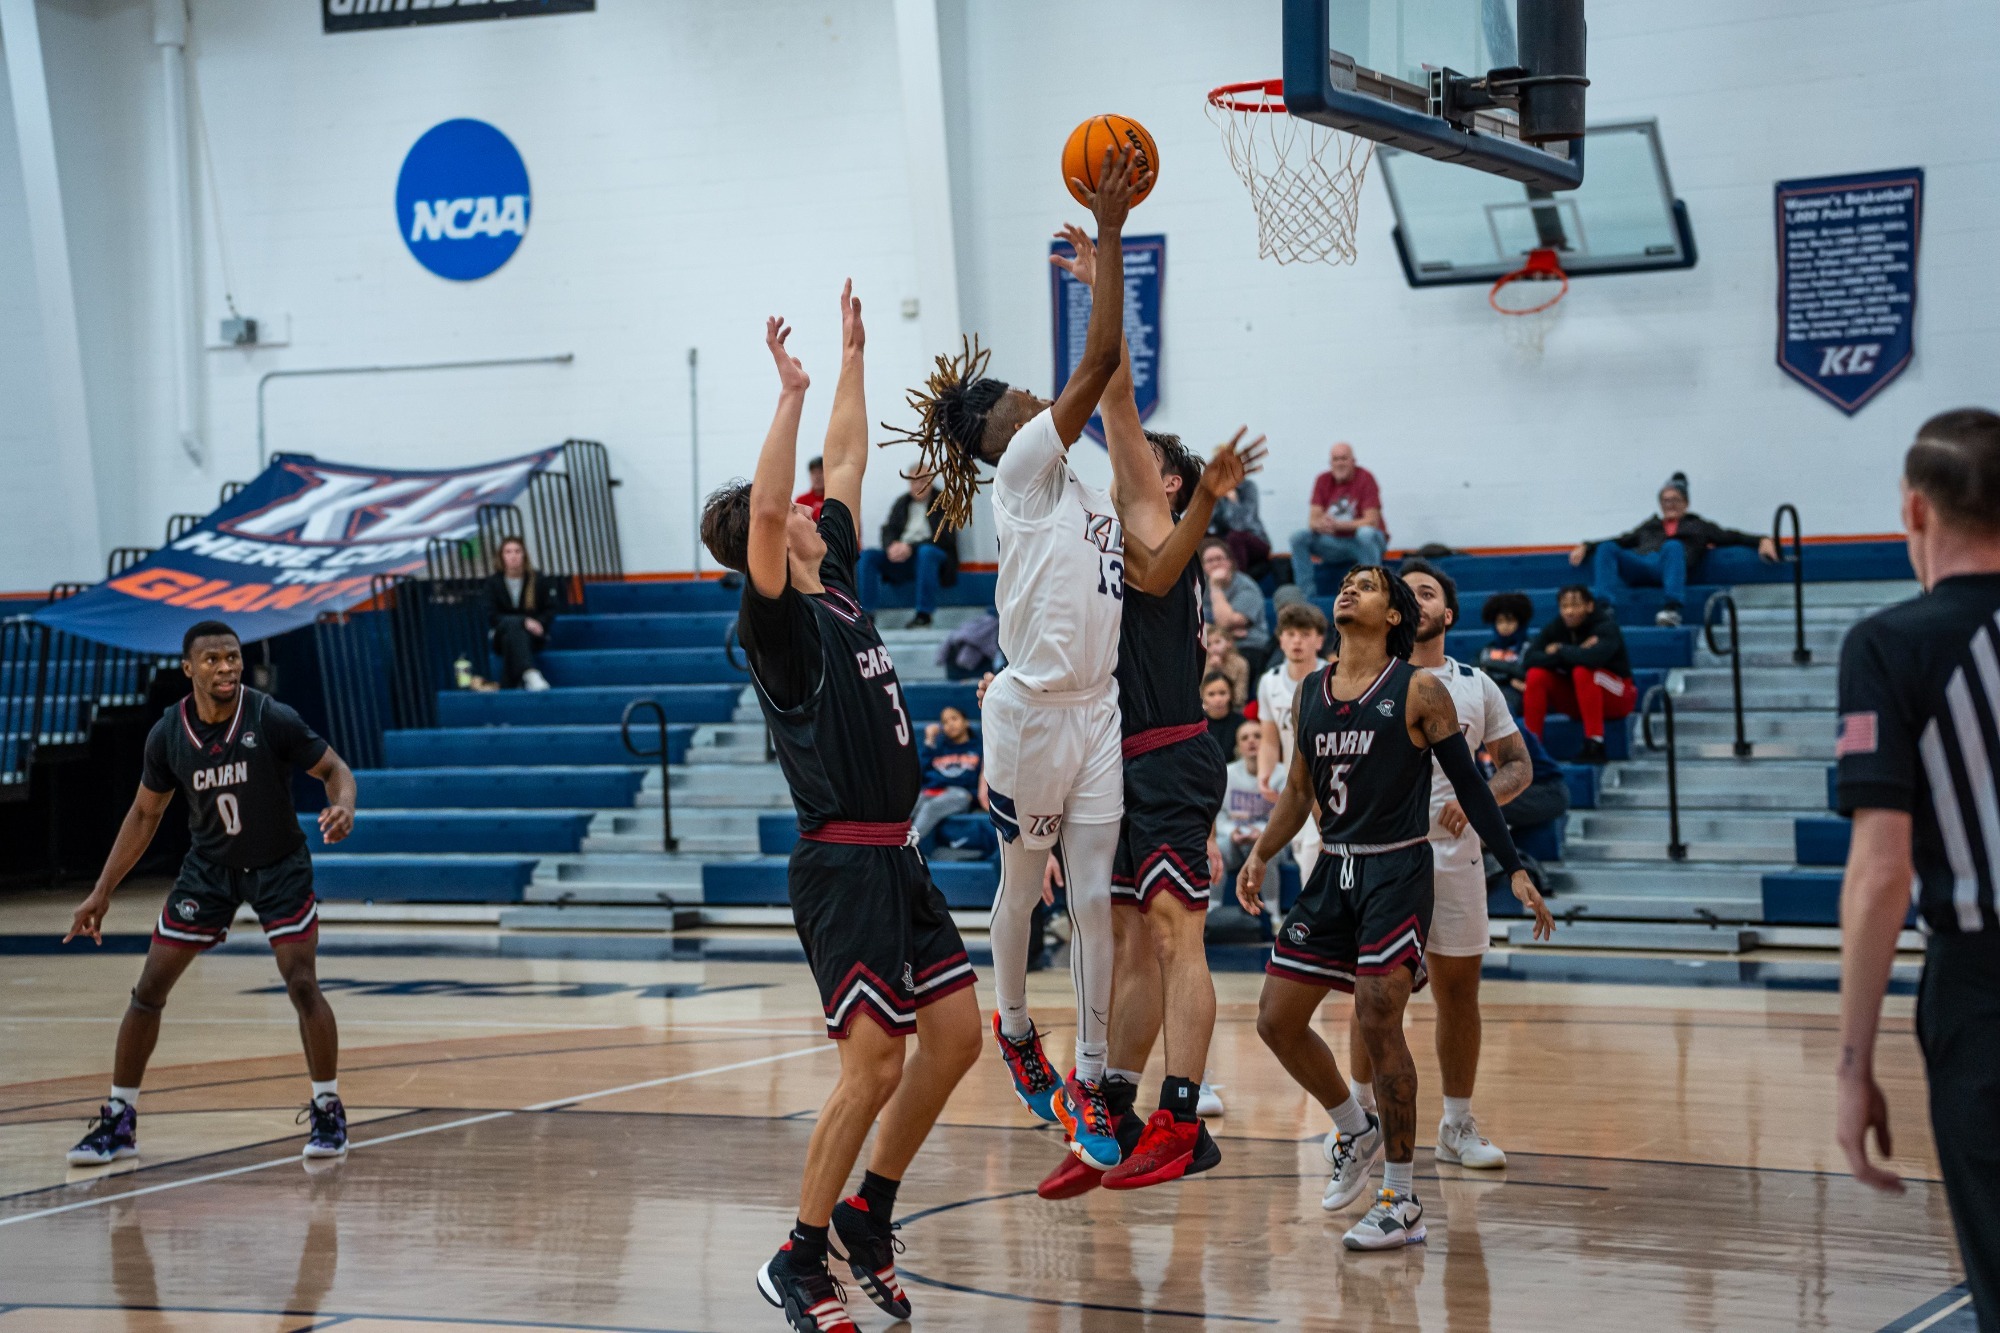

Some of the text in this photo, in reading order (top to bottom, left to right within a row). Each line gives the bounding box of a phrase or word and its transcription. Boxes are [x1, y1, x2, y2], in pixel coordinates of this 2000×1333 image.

[410, 195, 525, 242] NCAA
[1819, 343, 1881, 377] KC
[172, 531, 335, 569] HERE
[1098, 554, 1124, 601] 13
[883, 681, 910, 746] 3
[1315, 730, 1375, 757] CAIRN
[193, 761, 248, 791] CAIRN
[1328, 763, 1351, 815] 5
[216, 793, 242, 836] 0
